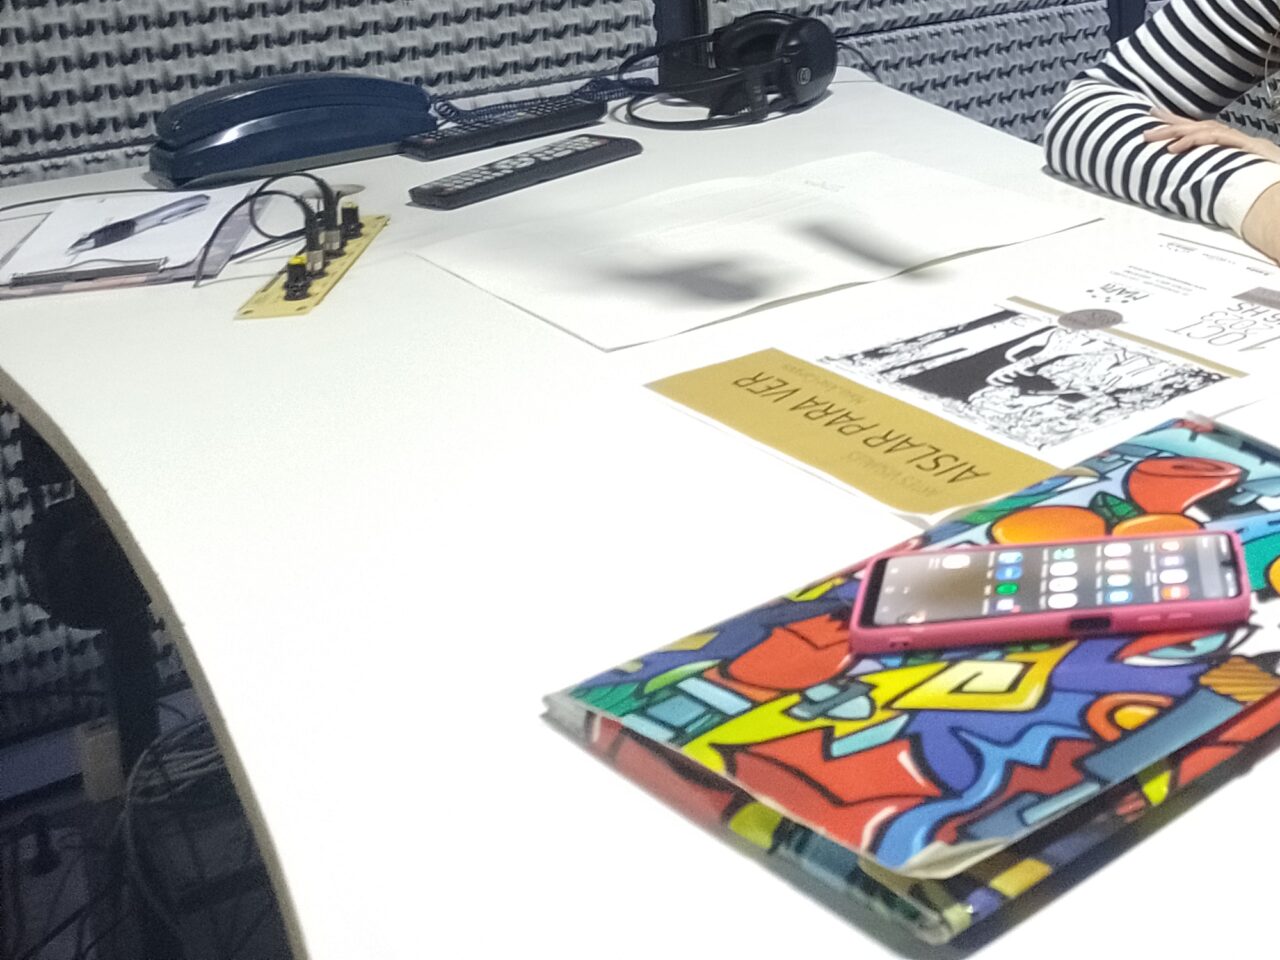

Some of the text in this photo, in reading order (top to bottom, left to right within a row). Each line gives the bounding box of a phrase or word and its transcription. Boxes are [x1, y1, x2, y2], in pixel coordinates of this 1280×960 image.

[732, 371, 802, 412] VER
[788, 395, 880, 438] PARA
[862, 428, 992, 485] AISLAR
